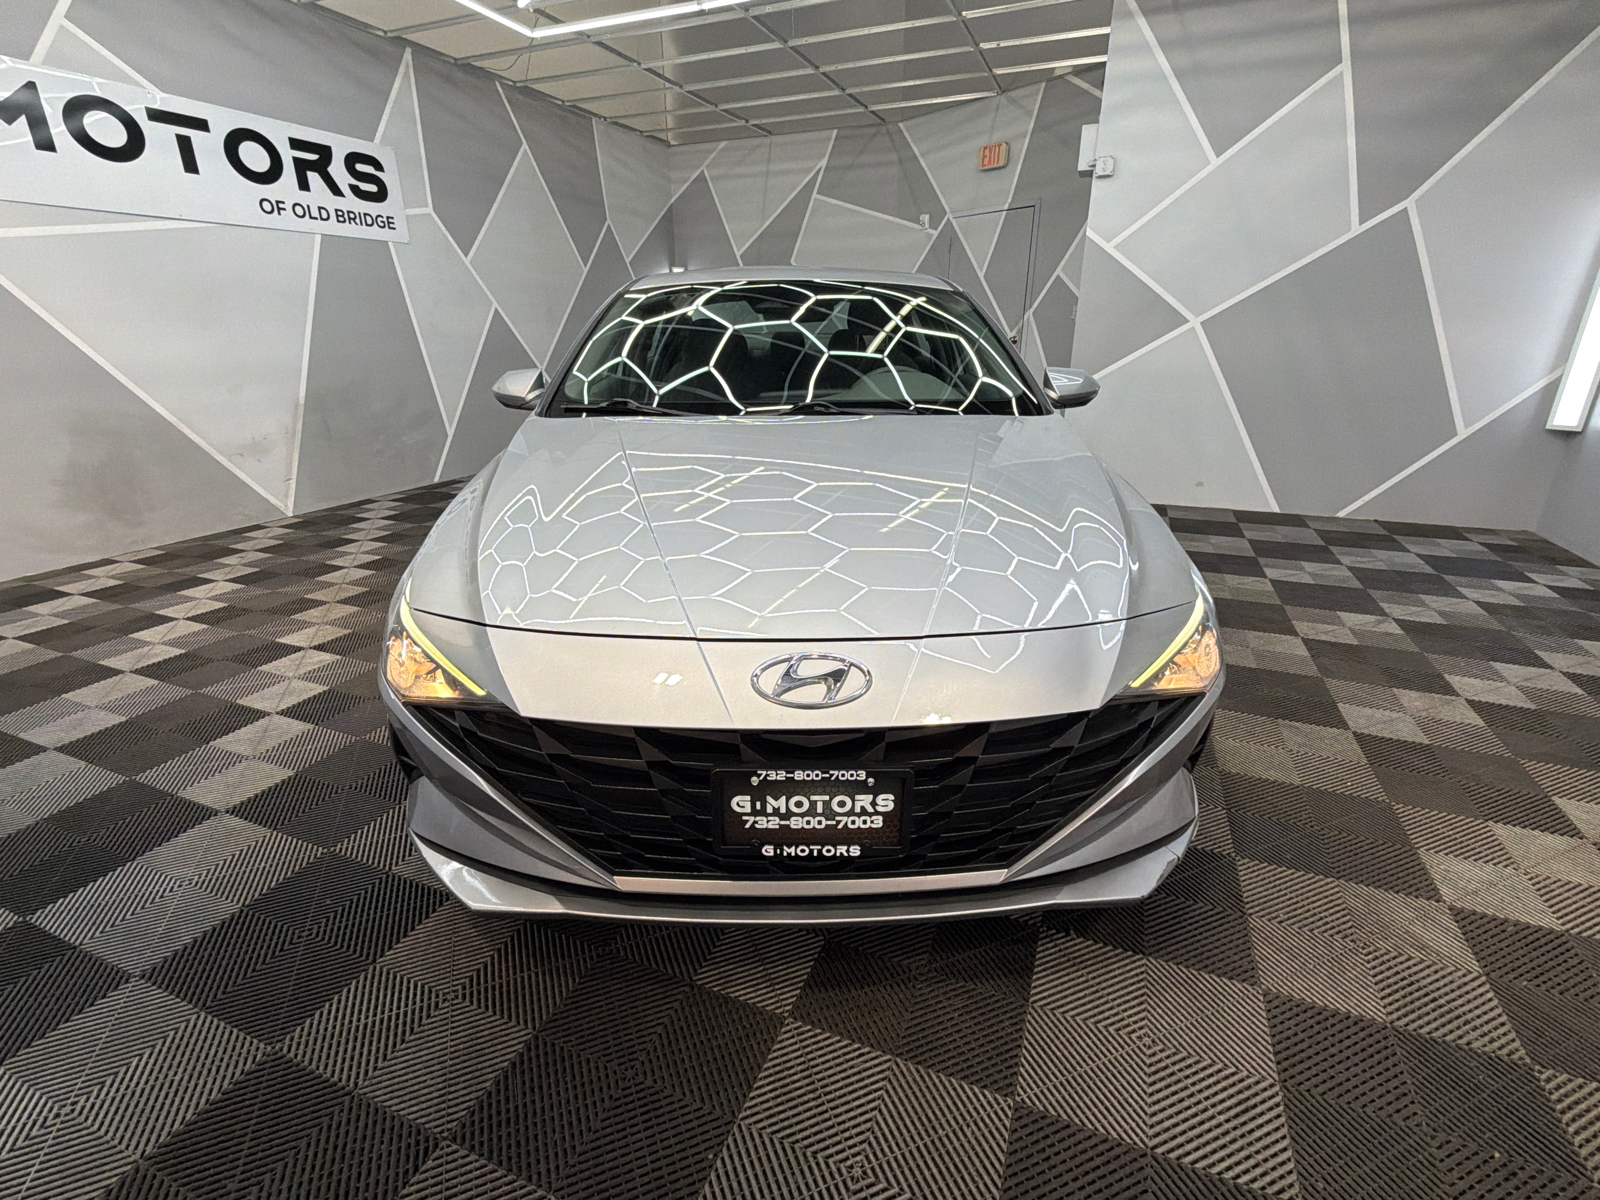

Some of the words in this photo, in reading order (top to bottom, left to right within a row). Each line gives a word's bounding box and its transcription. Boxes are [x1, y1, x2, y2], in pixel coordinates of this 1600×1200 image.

[982, 143, 1002, 167] EXIT
[259, 197, 287, 216] OF
[291, 202, 331, 222] OLD
[335, 208, 397, 231] BRIDGE
[757, 770, 866, 780] 732-800-7003
[742, 816, 883, 829] 732-800-7003
